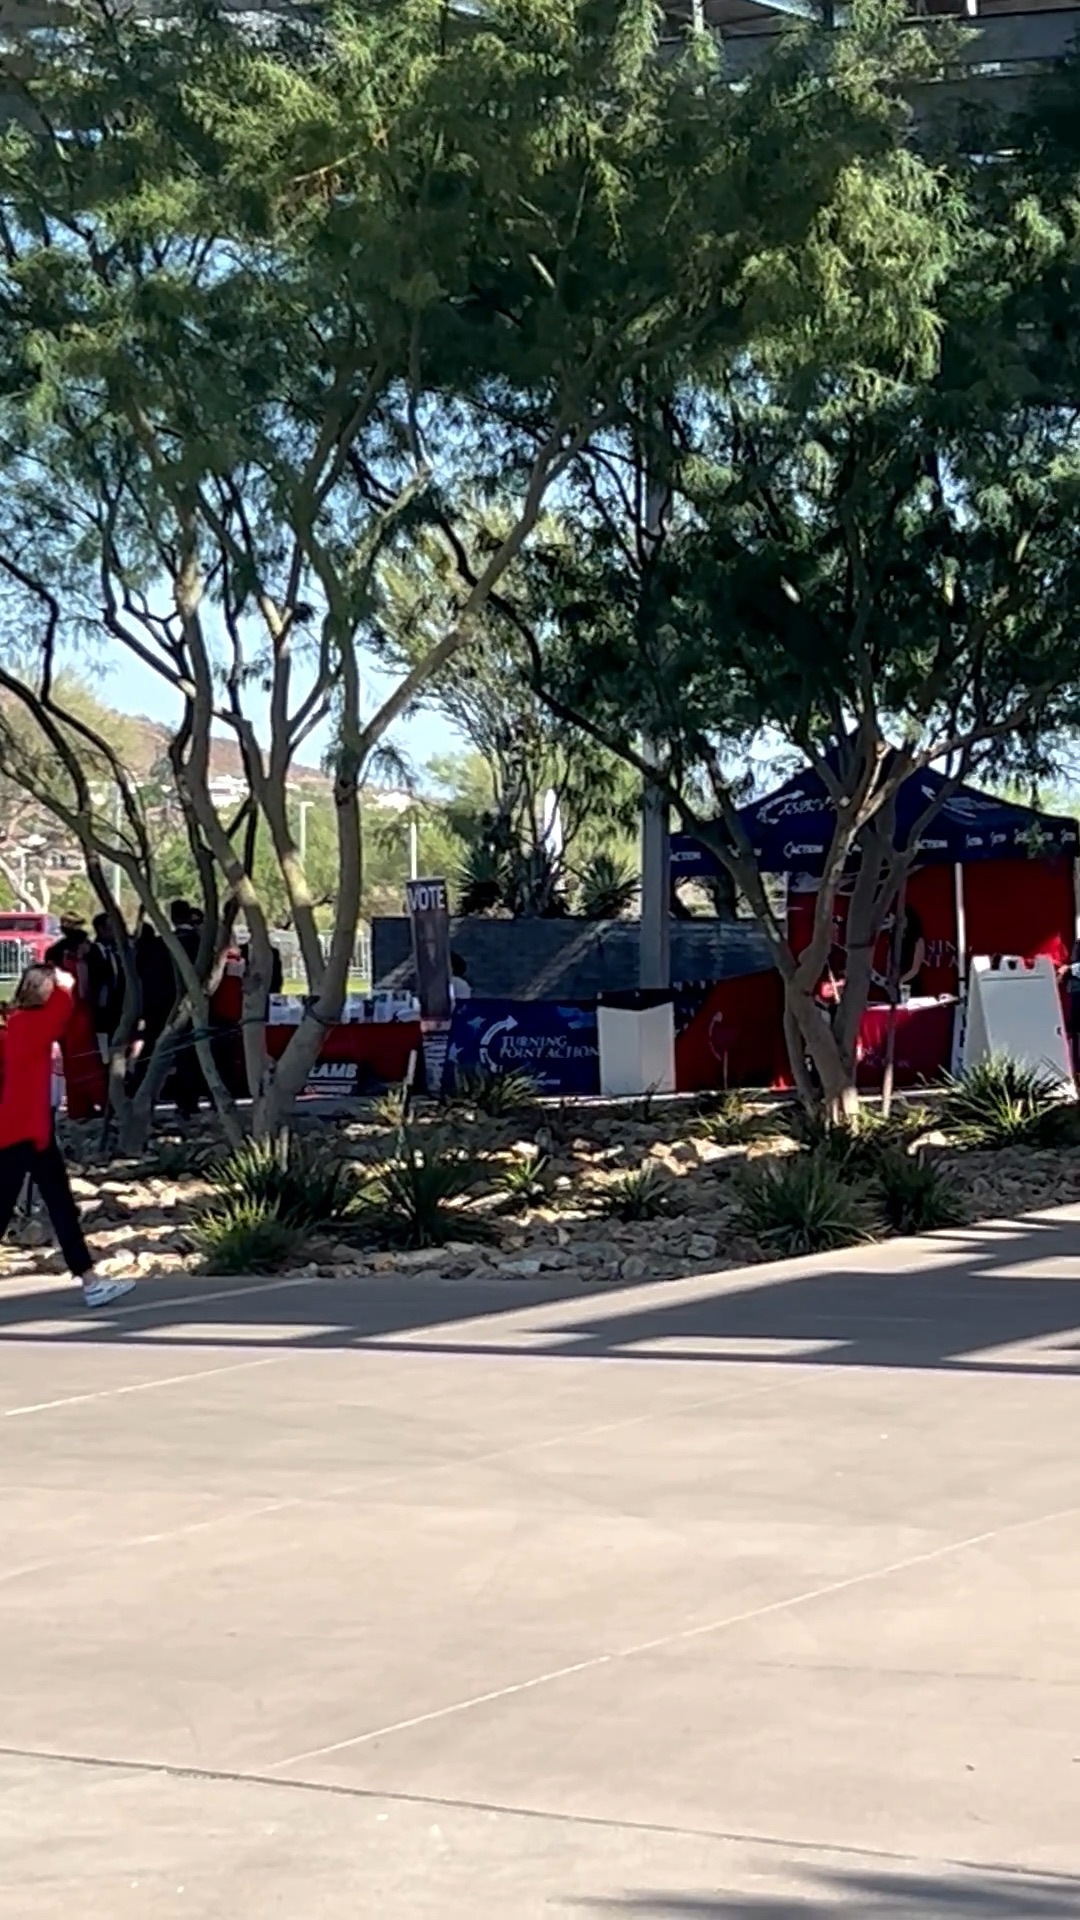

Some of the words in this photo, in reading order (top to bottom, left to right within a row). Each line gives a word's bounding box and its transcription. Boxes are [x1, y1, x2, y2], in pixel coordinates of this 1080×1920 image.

[408, 885, 446, 911] VOTE
[502, 1035, 568, 1048] TURNING
[500, 1046, 543, 1058] POINT
[546, 1045, 600, 1058] ACTION
[308, 1063, 358, 1078] LAMB
